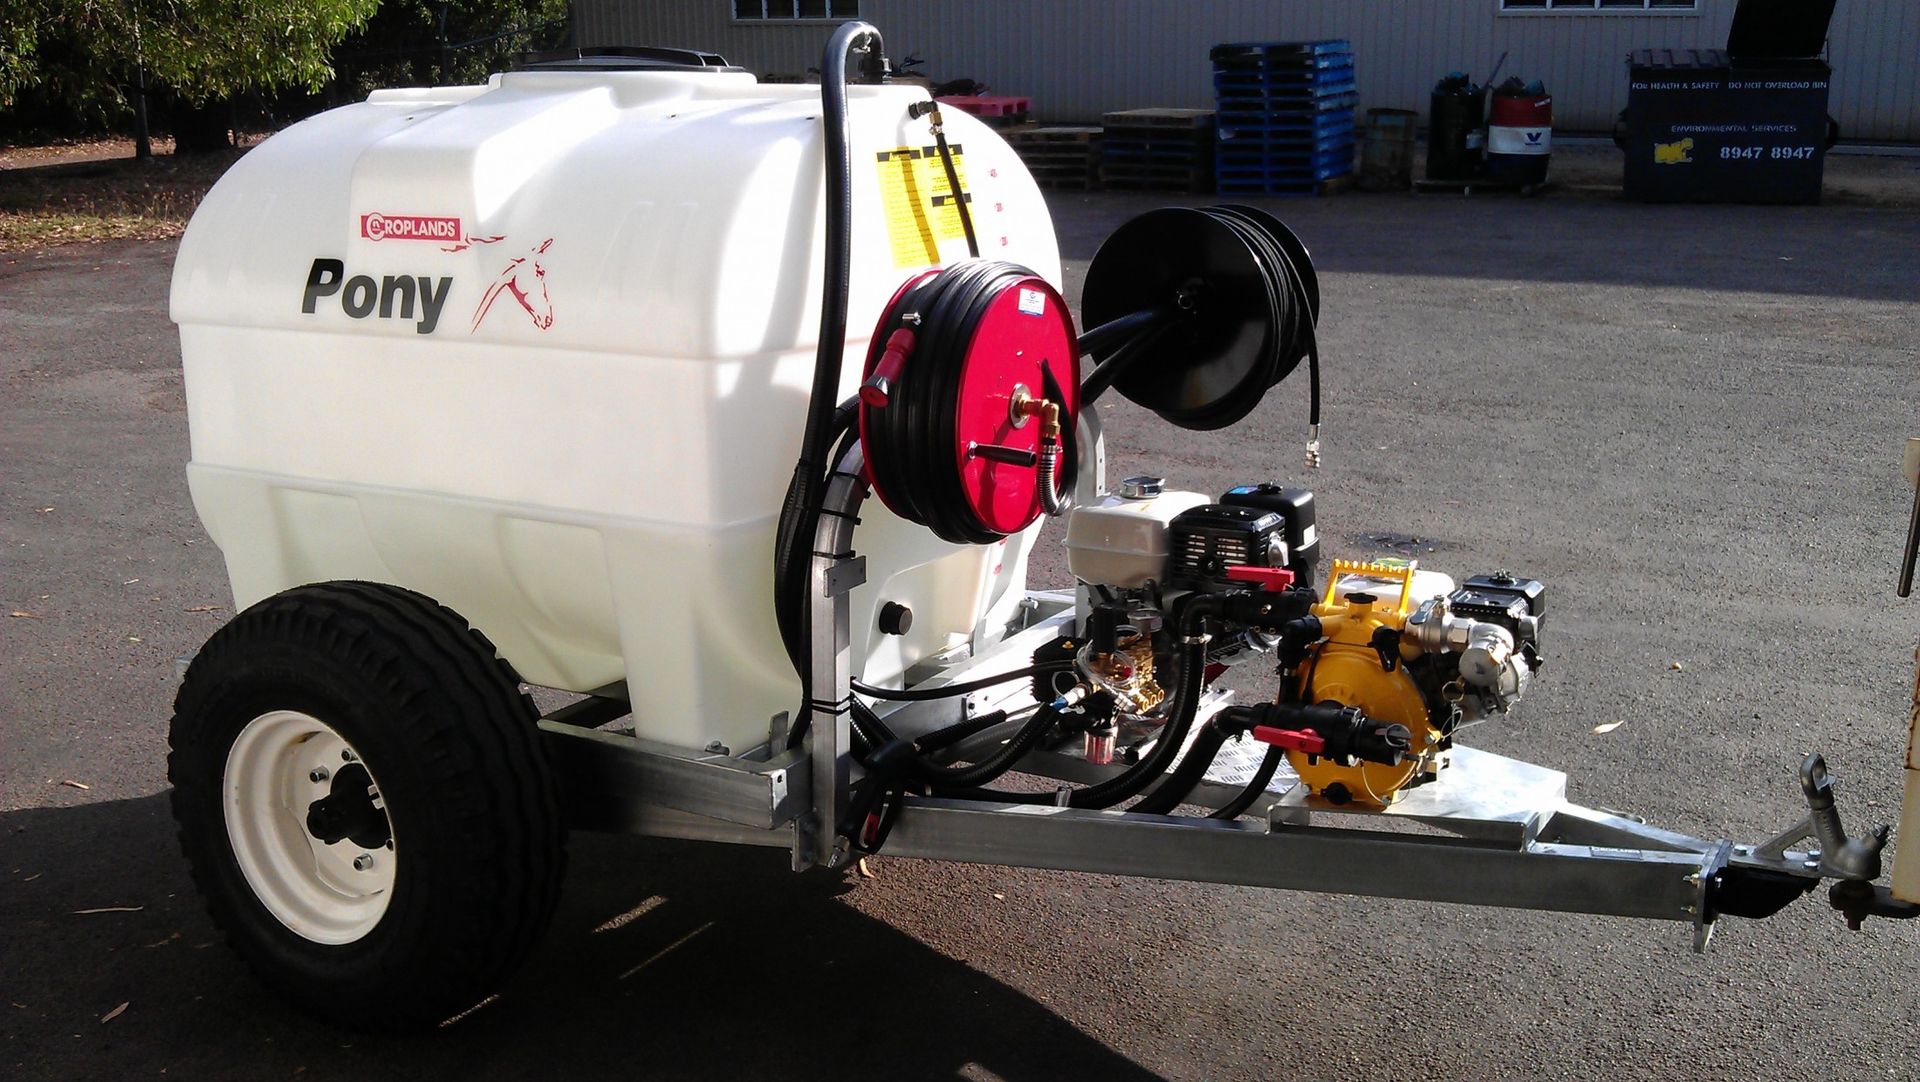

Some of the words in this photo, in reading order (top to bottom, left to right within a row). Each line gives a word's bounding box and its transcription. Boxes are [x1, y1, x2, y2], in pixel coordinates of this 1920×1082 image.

[1632, 82, 1648, 90] FOR
[1650, 82, 1680, 90] HEALTH
[1728, 81, 1742, 89] DO
[1744, 81, 1761, 89] NOT
[1765, 81, 1810, 89] OVERLOAD
[1812, 81, 1827, 89] BIN
[1671, 125, 1748, 133] ENVIRONMENTAL
[1751, 125, 1797, 133] SERVICES
[1720, 146, 1763, 159] 8947
[1771, 146, 1814, 159] 8947
[366, 212, 456, 241] CROPLANDS
[301, 258, 453, 334] Pony
